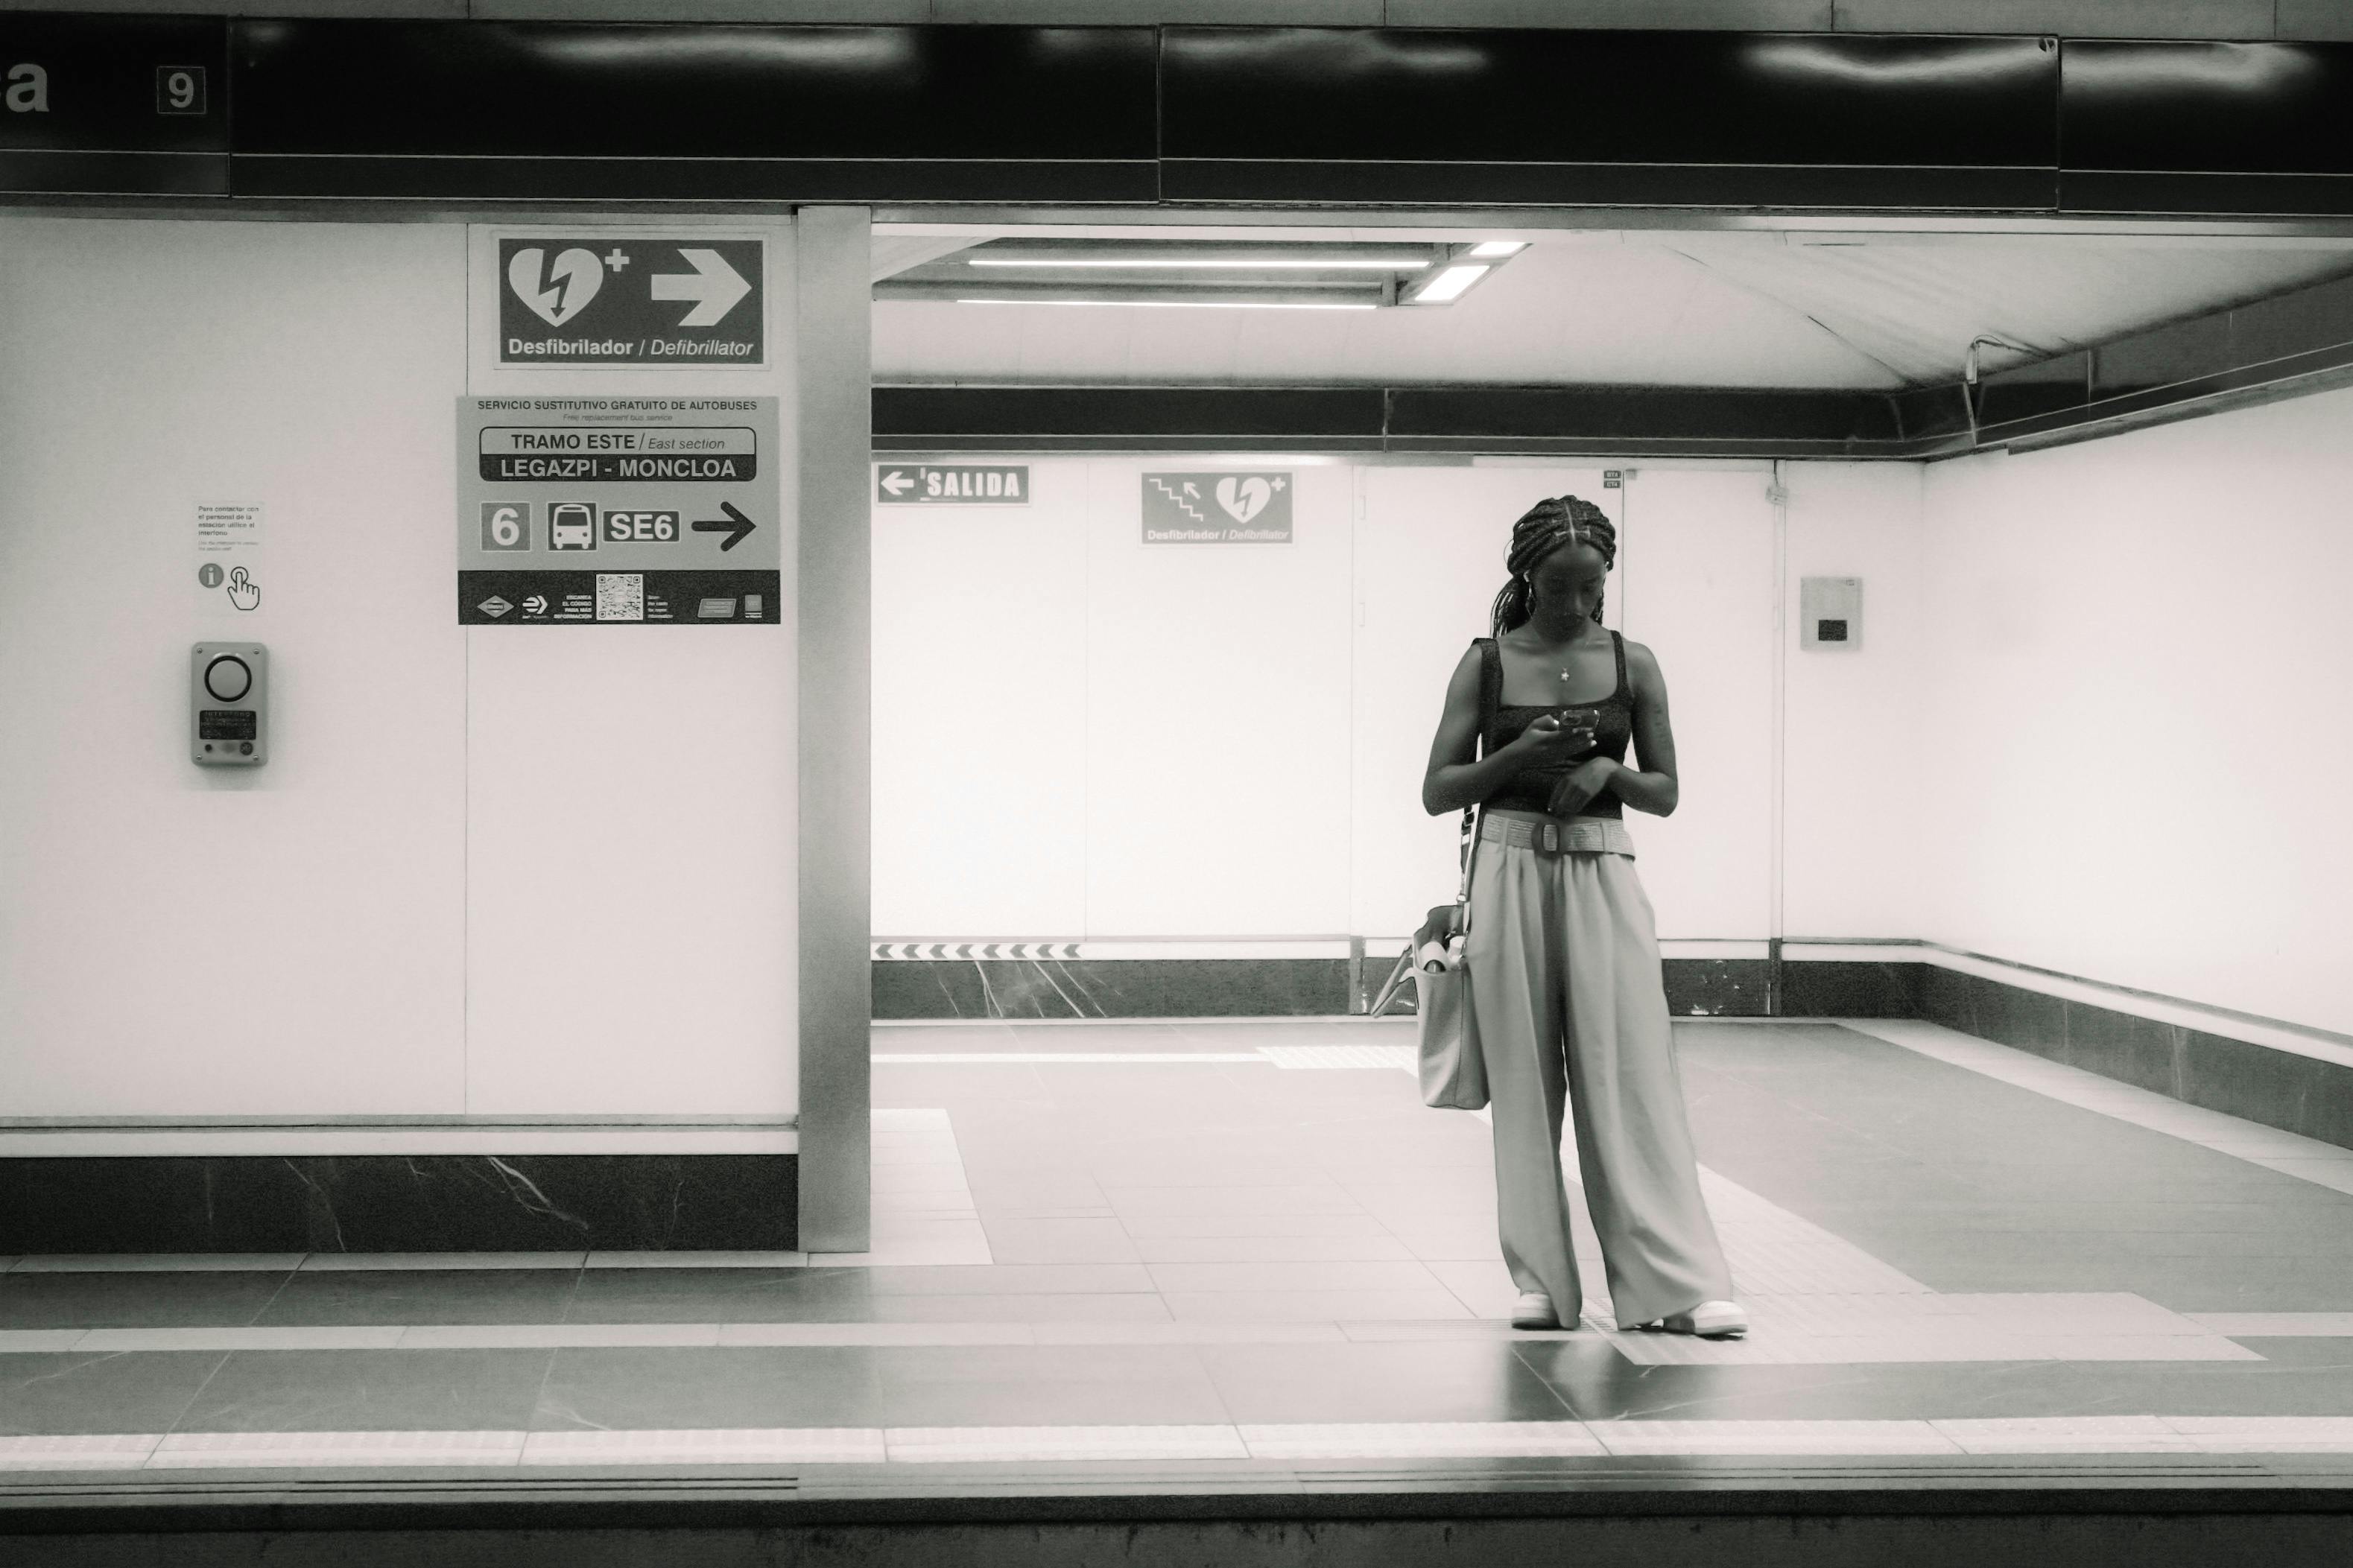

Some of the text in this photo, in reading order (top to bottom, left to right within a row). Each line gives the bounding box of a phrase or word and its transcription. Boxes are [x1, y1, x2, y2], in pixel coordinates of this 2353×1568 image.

[0, 64, 49, 112] a
[168, 72, 194, 108] 9
[509, 339, 754, 357] Desfibrilador / Defibrillator
[478, 401, 757, 410] SERVICIO SUSTITUTIVO GRATUITO DE AUTOBUSES
[511, 433, 725, 451] TRAMO ESTE / East section
[501, 460, 597, 477] LEGAZPI
[619, 460, 737, 477] MONCLOA
[927, 472, 1019, 497] SALIDA
[492, 508, 673, 546] 6 SE6
[1147, 530, 1219, 540] Desfibrilador
[1229, 530, 1289, 540] Defibrillator
